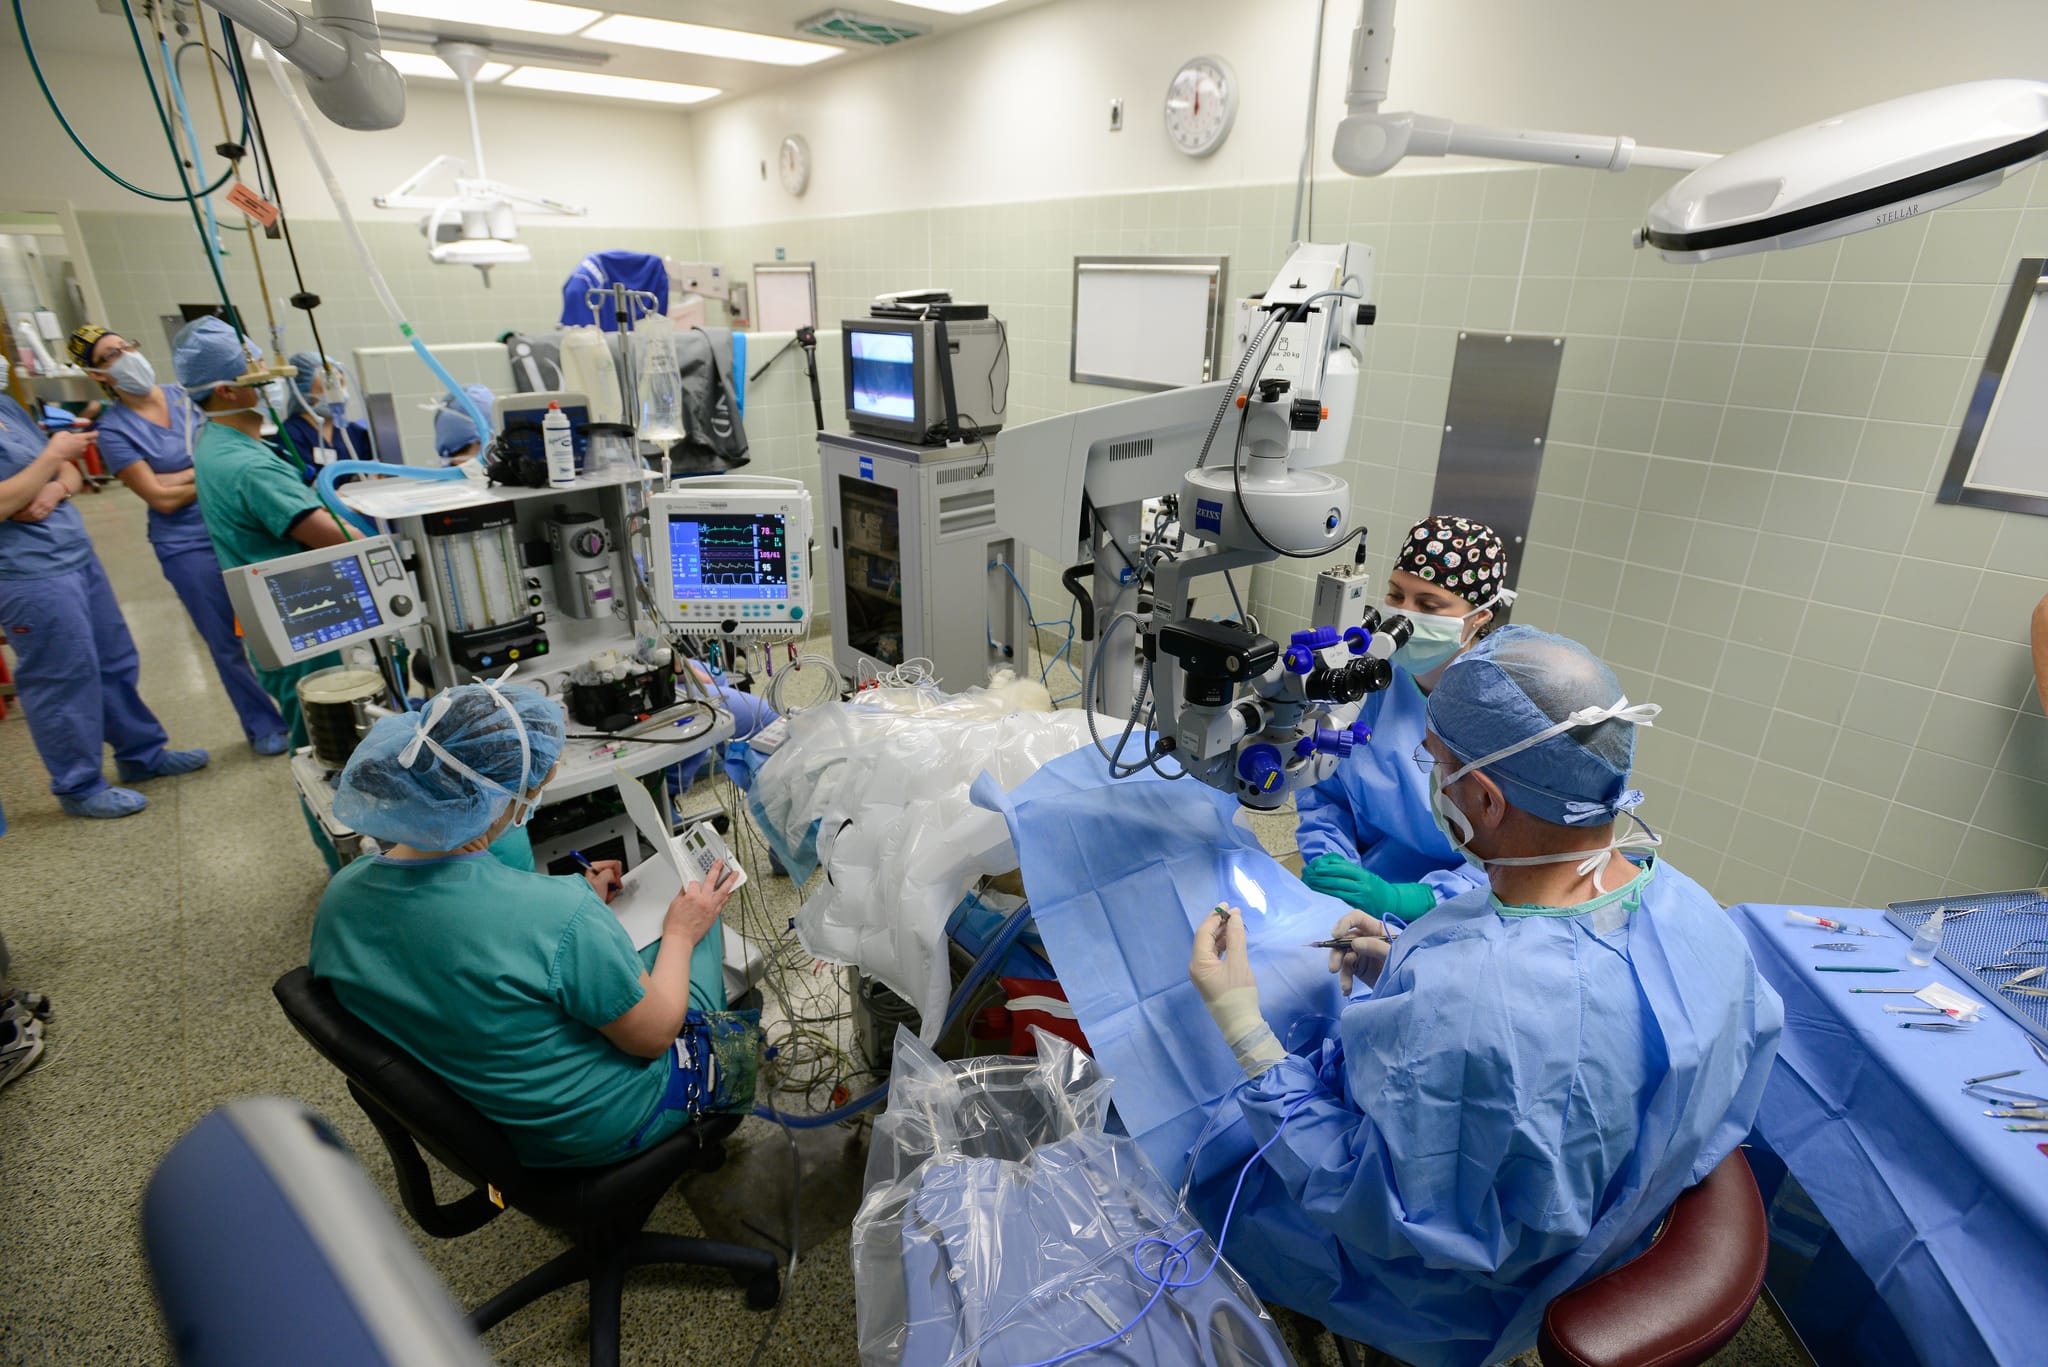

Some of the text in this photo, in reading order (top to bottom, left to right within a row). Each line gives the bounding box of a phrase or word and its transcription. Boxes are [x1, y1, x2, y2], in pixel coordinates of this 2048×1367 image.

[1876, 203, 1919, 224] STELLAR
[1197, 508, 1221, 520] ZEISS
[762, 563, 772, 571] 95
